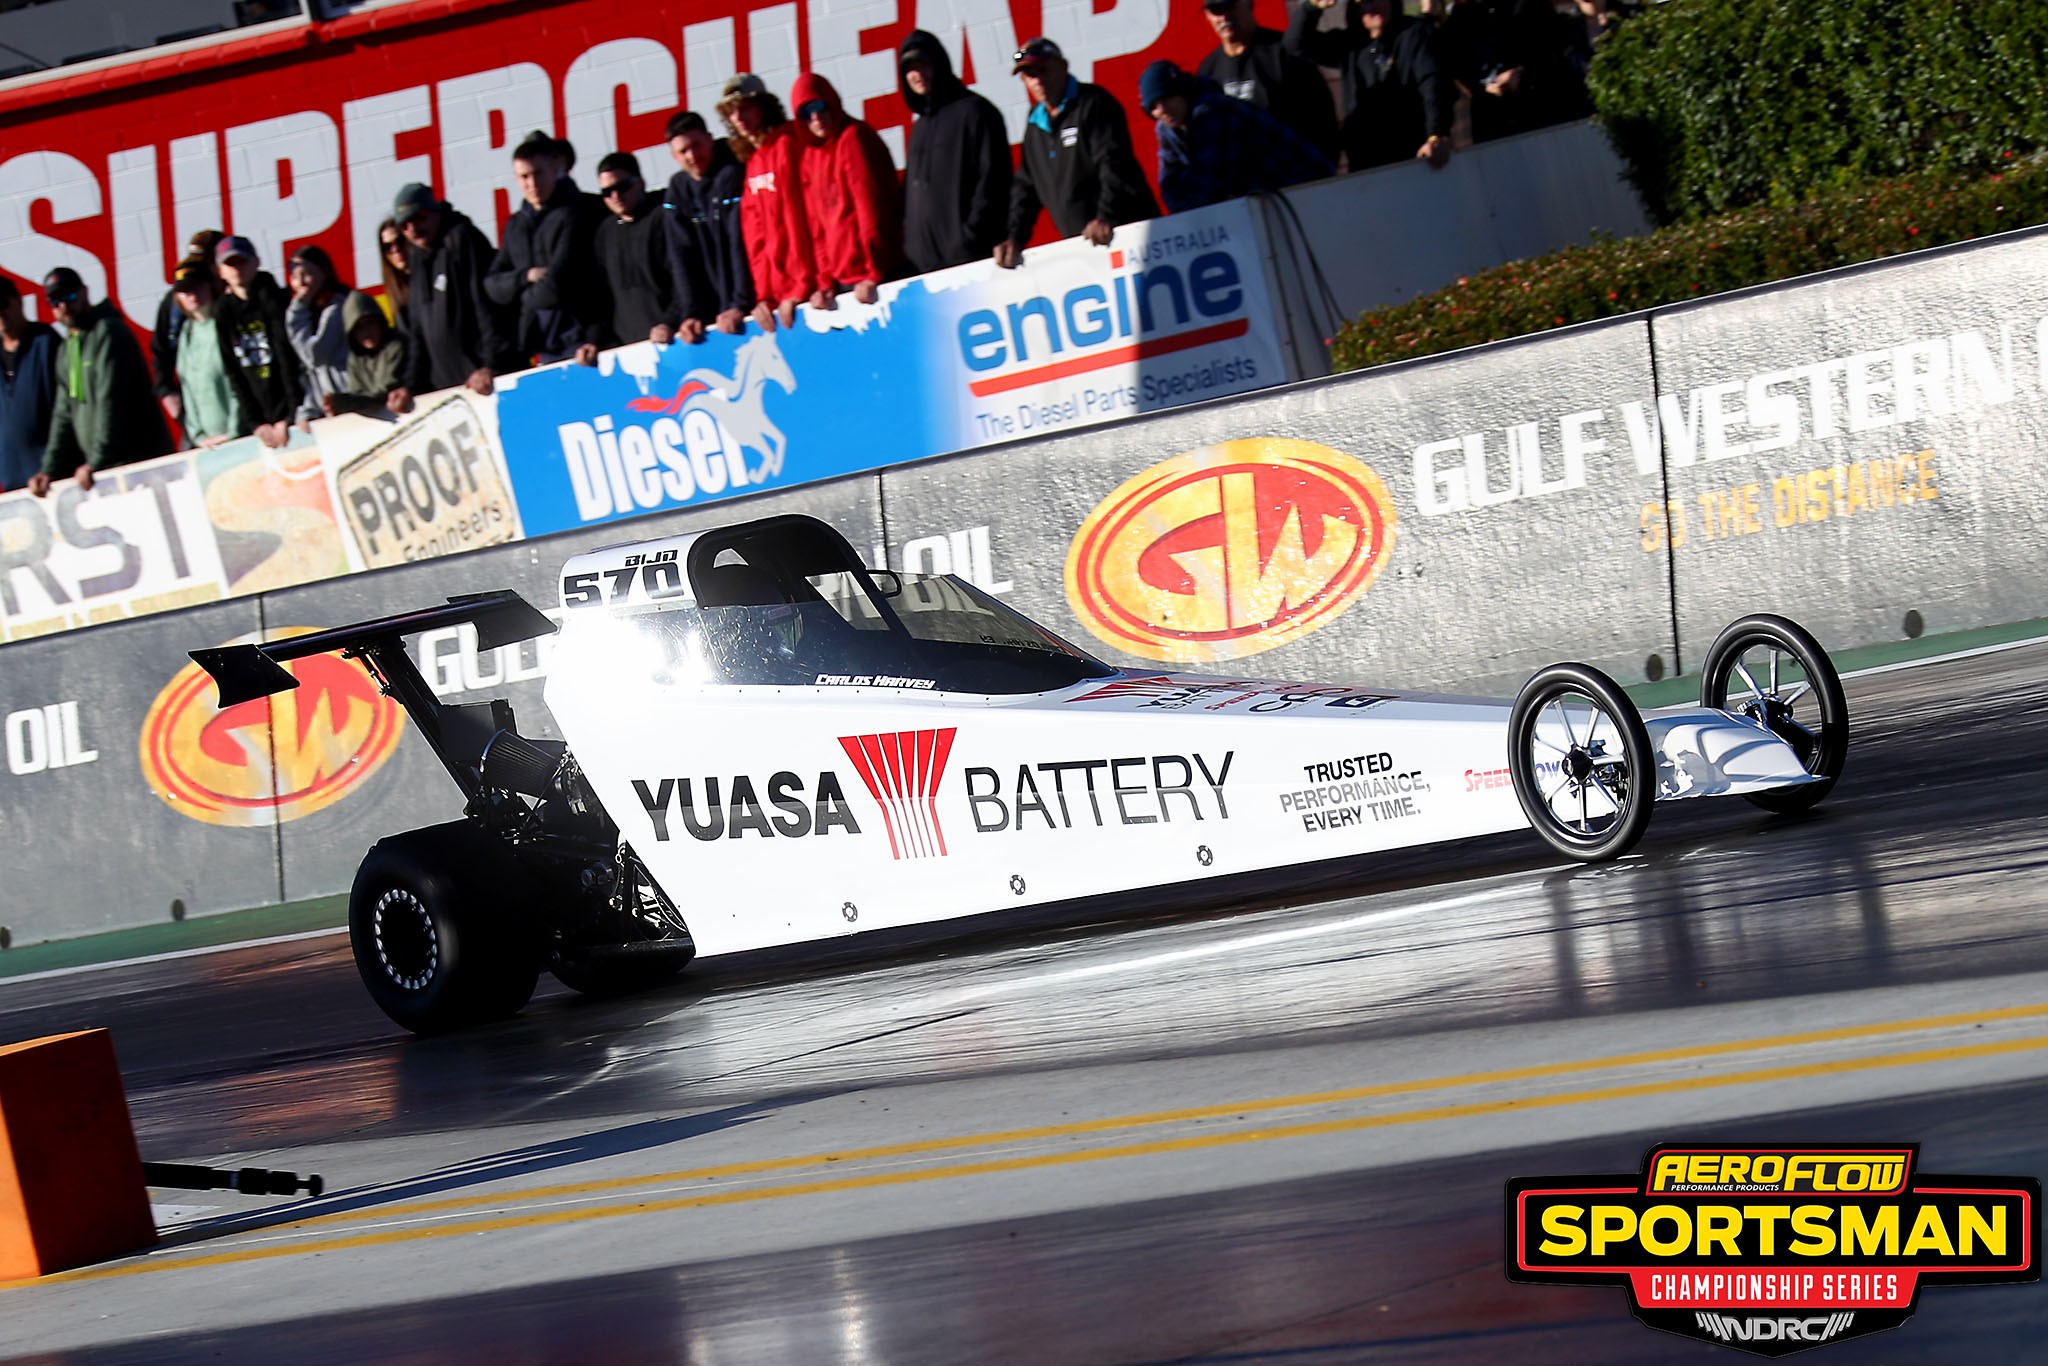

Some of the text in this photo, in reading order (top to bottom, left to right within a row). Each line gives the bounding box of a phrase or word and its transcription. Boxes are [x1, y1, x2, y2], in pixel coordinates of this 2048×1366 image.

[1127, 225, 1230, 265] AUSTRALIA
[976, 355, 1258, 438] The Diesel Parts Specialists
[1412, 408, 1606, 517] GULF
[1619, 322, 2015, 476] WESTERN
[349, 421, 479, 556] PROOF
[558, 410, 749, 521] Diesel
[1698, 482, 1763, 542] THE
[1773, 448, 1938, 529] DISTANCE
[564, 562, 685, 609] 570
[902, 526, 1014, 614] OIL
[872, 675, 936, 689] HARVEY
[5, 701, 98, 775] OIL
[1303, 752, 1393, 783] TRUSTED
[631, 750, 1235, 842] YUASA BATTERY
[1280, 771, 1432, 813] PERFORMANCE,
[1302, 796, 1422, 833] EVERY TIME.
